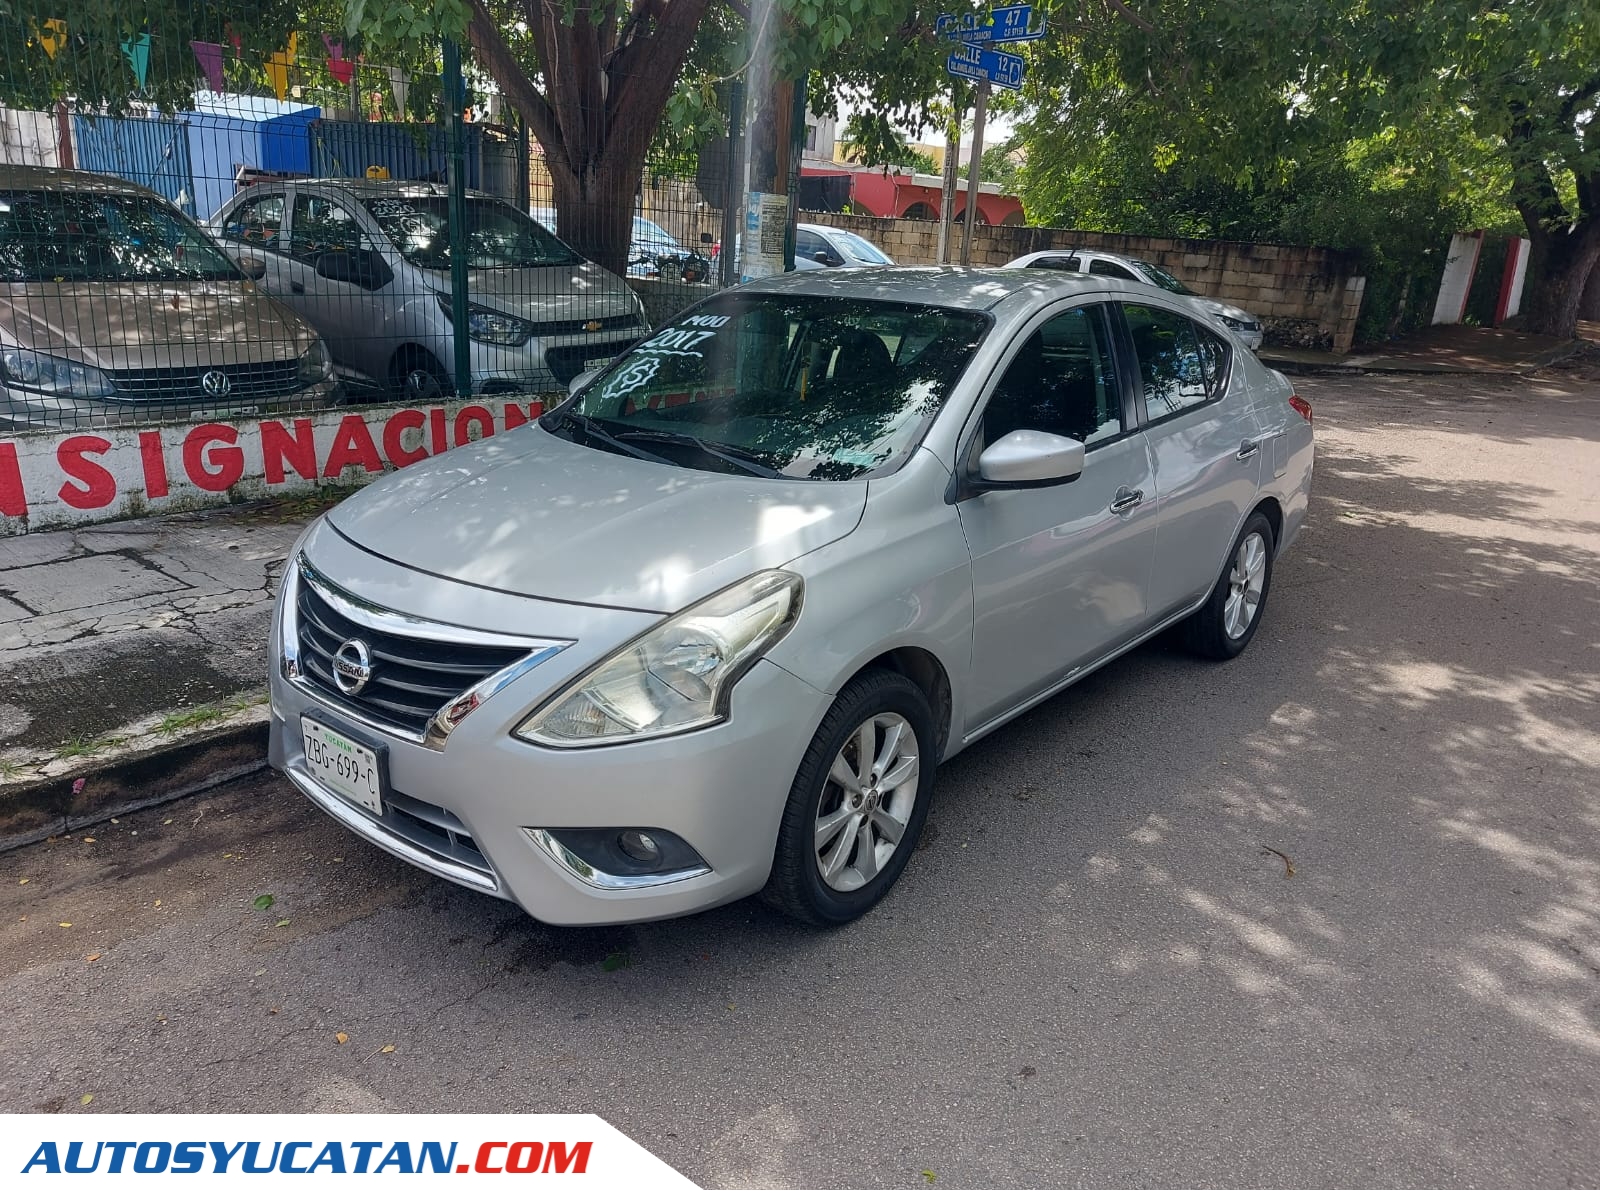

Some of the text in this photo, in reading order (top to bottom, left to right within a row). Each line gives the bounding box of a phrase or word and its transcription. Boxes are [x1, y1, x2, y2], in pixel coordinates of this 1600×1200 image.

[1005, 10, 1021, 26] 47
[998, 55, 1008, 71] 12
[372, 205, 416, 214] 2020
[639, 327, 717, 351] 2017
[334, 658, 364, 678] NISSAN
[305, 735, 376, 794] ZBG-699-C
